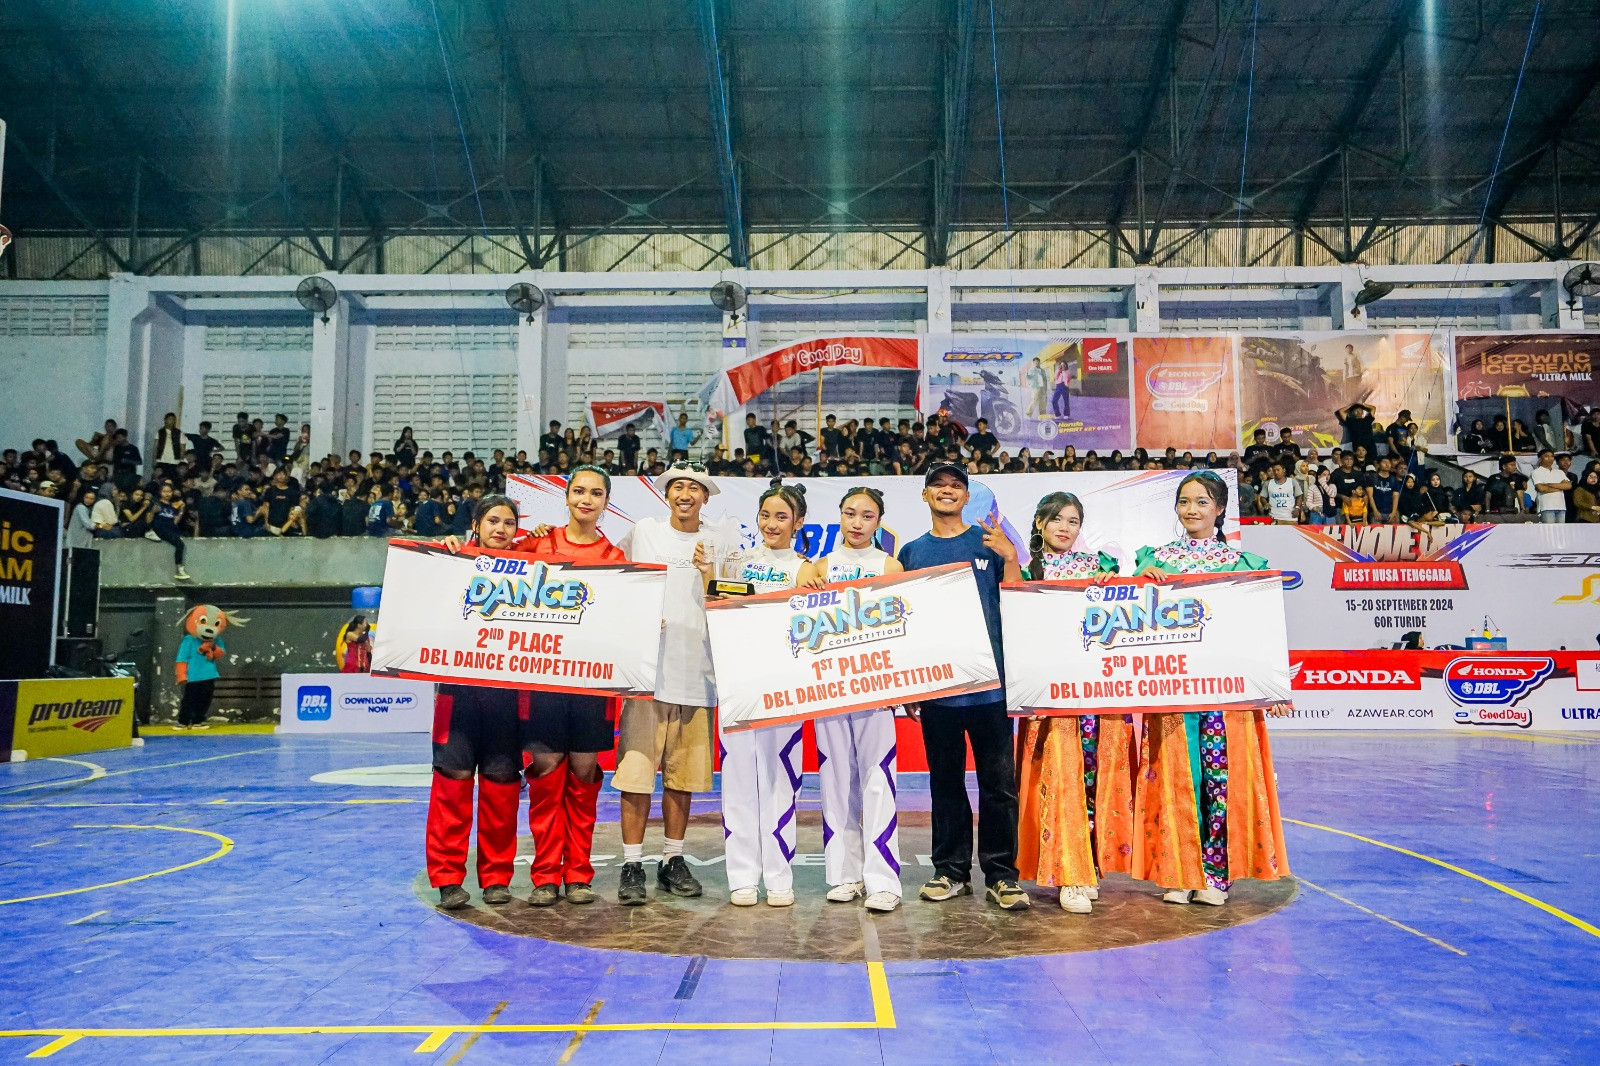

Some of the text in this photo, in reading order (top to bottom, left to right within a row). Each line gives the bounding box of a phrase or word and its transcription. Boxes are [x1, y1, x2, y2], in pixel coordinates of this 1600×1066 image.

[1481, 363, 1592, 374] ICE CREAM
[1539, 373, 1567, 382] ULTRA
[1569, 373, 1592, 381] MILK
[1168, 381, 1187, 390] DBL
[1276, 500, 1288, 508] 22
[491, 558, 528, 575] DBL
[975, 558, 989, 570] W
[1344, 569, 1452, 582] WEST NUSA TENGGARA
[0, 585, 31, 606] MILK
[469, 563, 583, 616] DANCE
[1103, 585, 1139, 601] DBL
[807, 591, 841, 608] DBL
[1346, 599, 1454, 611] 15-20 SEPTEMBER 2024
[502, 611, 576, 620] COMPETITION
[791, 588, 900, 650] DANCE
[1085, 586, 1200, 645] DANCE
[1374, 616, 1427, 628] GOR TURIDE
[476, 628, 564, 655] 2ND PLACE
[828, 627, 901, 646] COMPETITION
[1121, 633, 1197, 643] COMPETITION
[419, 647, 614, 680] DBL DANCE COMPETITION
[811, 650, 893, 680] 1ST PLACE
[1101, 654, 1188, 677] 3RD PLACE
[1304, 669, 1414, 684] HONDA
[1473, 668, 1527, 676] HONDA
[763, 663, 954, 710] DBL DANCE COMPETITION
[1050, 676, 1245, 700] DBL DANCE COMPETITION
[1474, 682, 1500, 694] DBL
[300, 694, 328, 707] DBL
[344, 697, 393, 705] DOWNLOAD
[28, 698, 124, 726] proteam
[1347, 708, 1434, 718] AZAWEAR.COM
